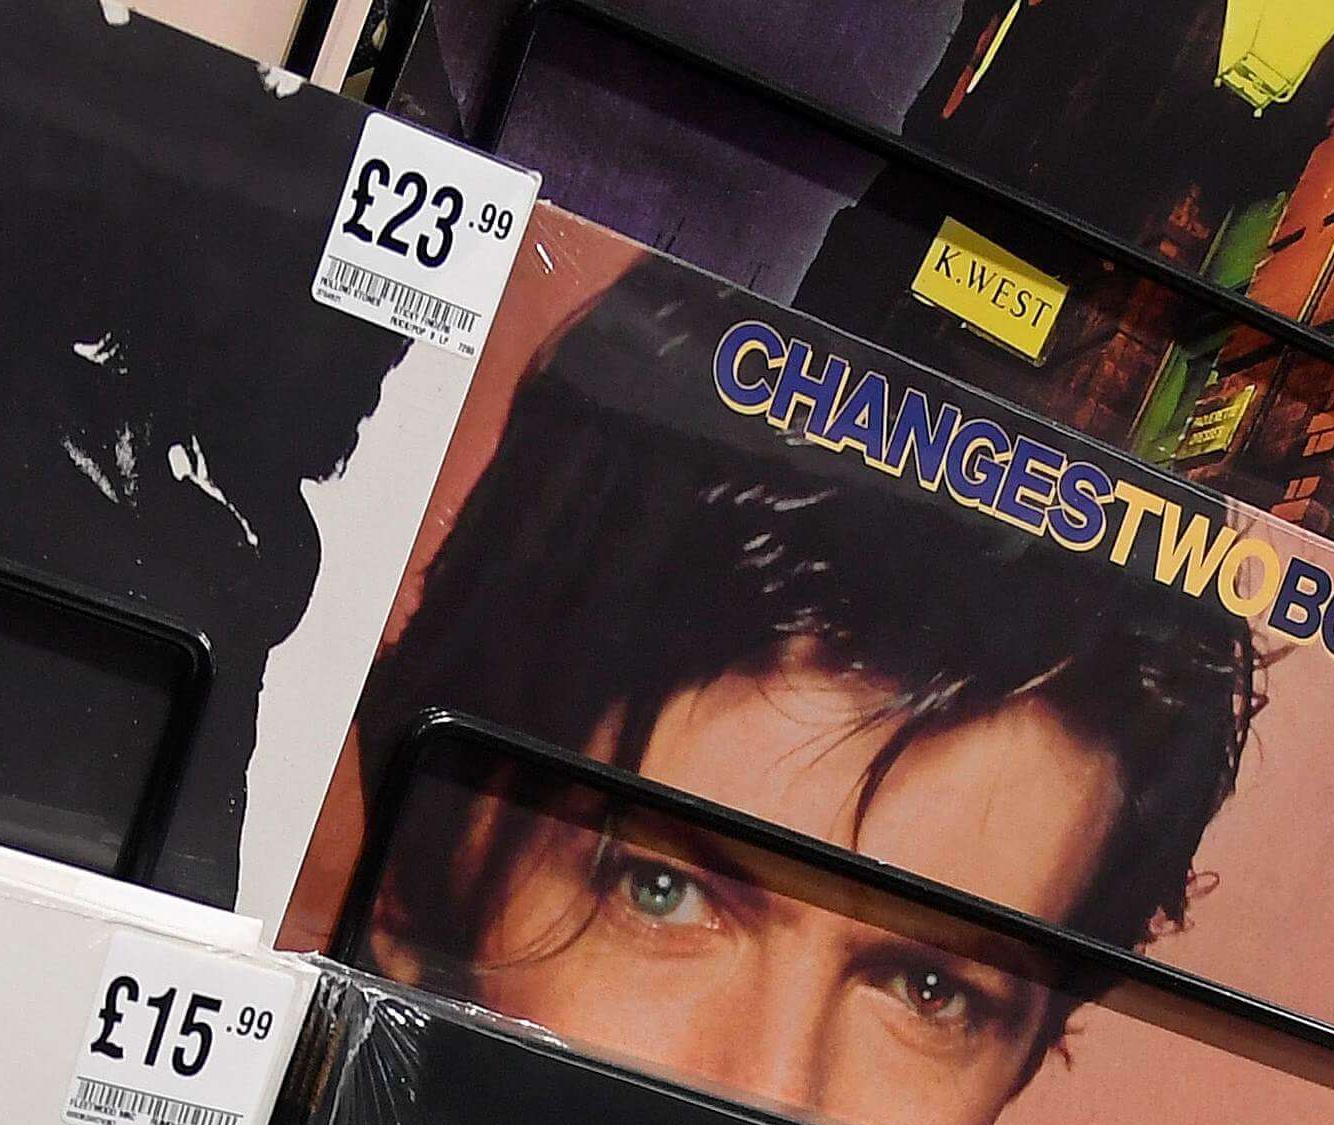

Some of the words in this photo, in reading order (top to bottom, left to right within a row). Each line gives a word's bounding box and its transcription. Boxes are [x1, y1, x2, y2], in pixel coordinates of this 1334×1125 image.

[342, 158, 514, 268] £23.99
[933, 244, 1053, 329] K.WEST
[90, 975, 273, 1077] £15.99
